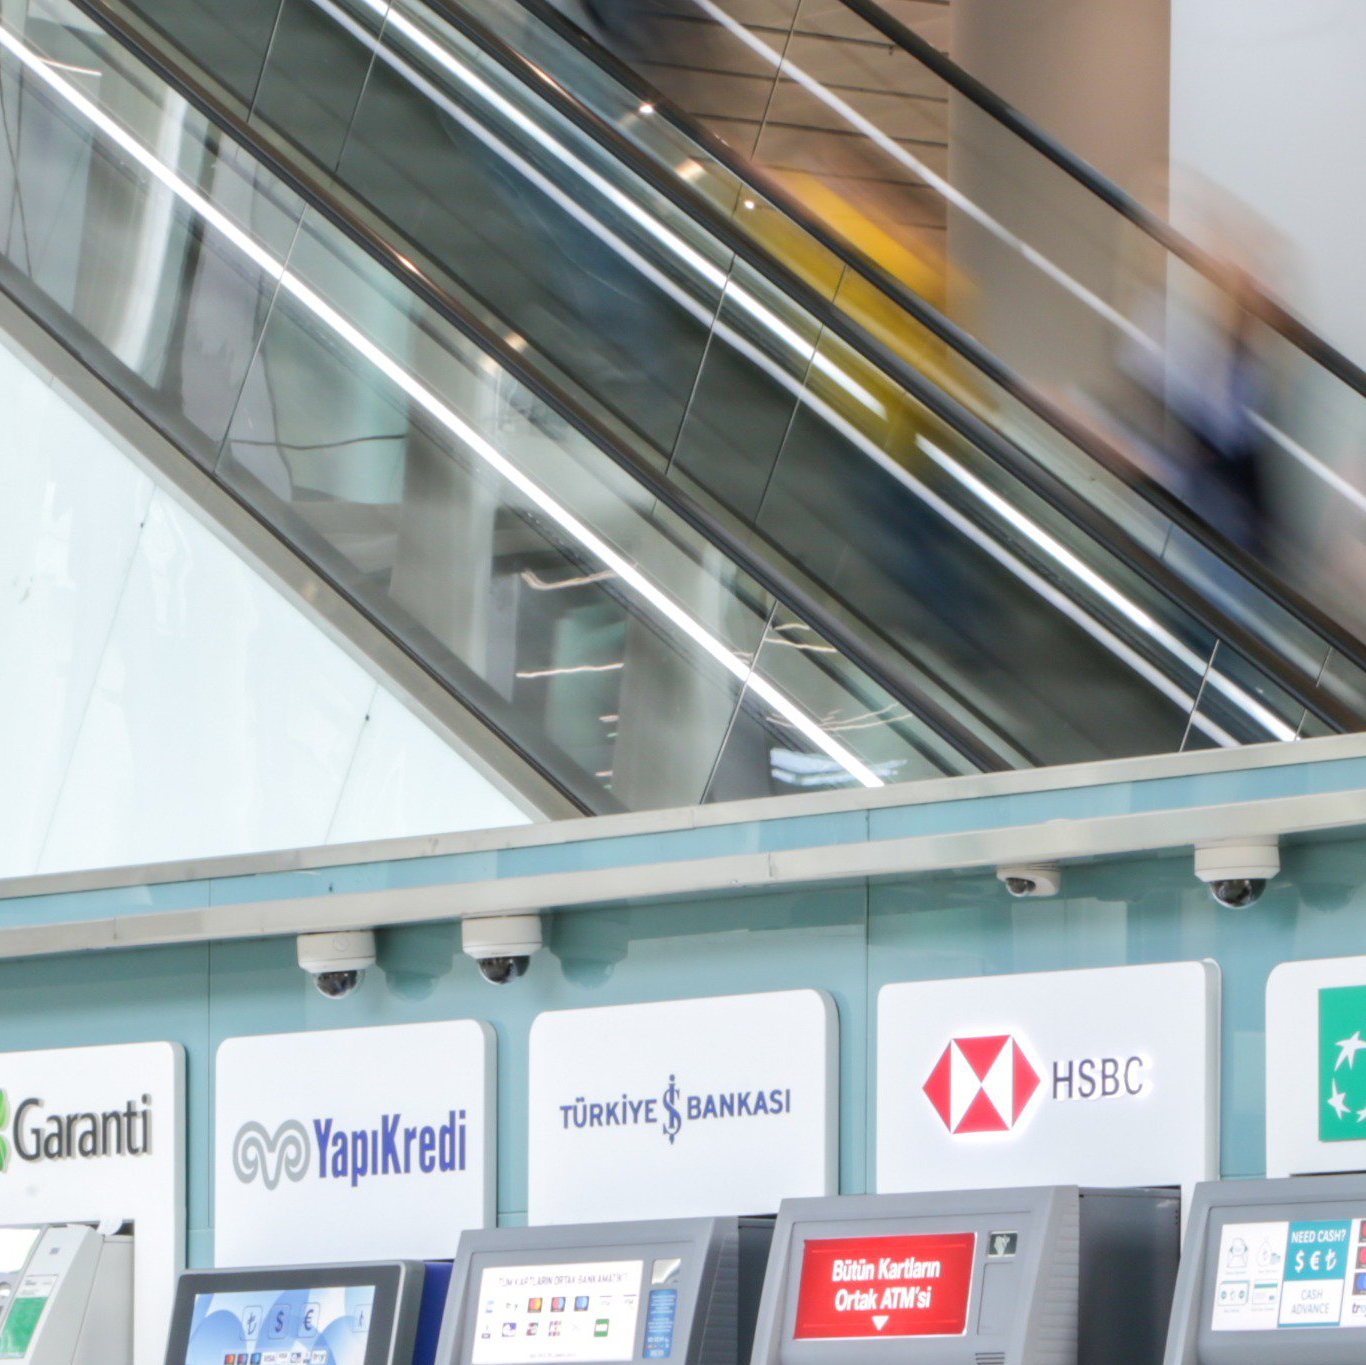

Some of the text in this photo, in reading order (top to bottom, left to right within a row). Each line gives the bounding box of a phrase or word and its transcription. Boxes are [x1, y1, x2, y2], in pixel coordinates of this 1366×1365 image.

[1052, 1056, 1143, 1099] HSBC
[560, 1094, 658, 1129] TÜRKİYE
[687, 1088, 792, 1120] BANKASI
[12, 1093, 152, 1161] Garanti
[312, 1109, 466, 1187] YapıKredi
[1291, 1228, 1347, 1243] NEED CASH?
[832, 1256, 941, 1282] Bütün Kartların
[835, 1286, 932, 1312] Ortak ATM'si
[1301, 1289, 1323, 1300] CASH
[1291, 1302, 1330, 1315] ADVANCE
